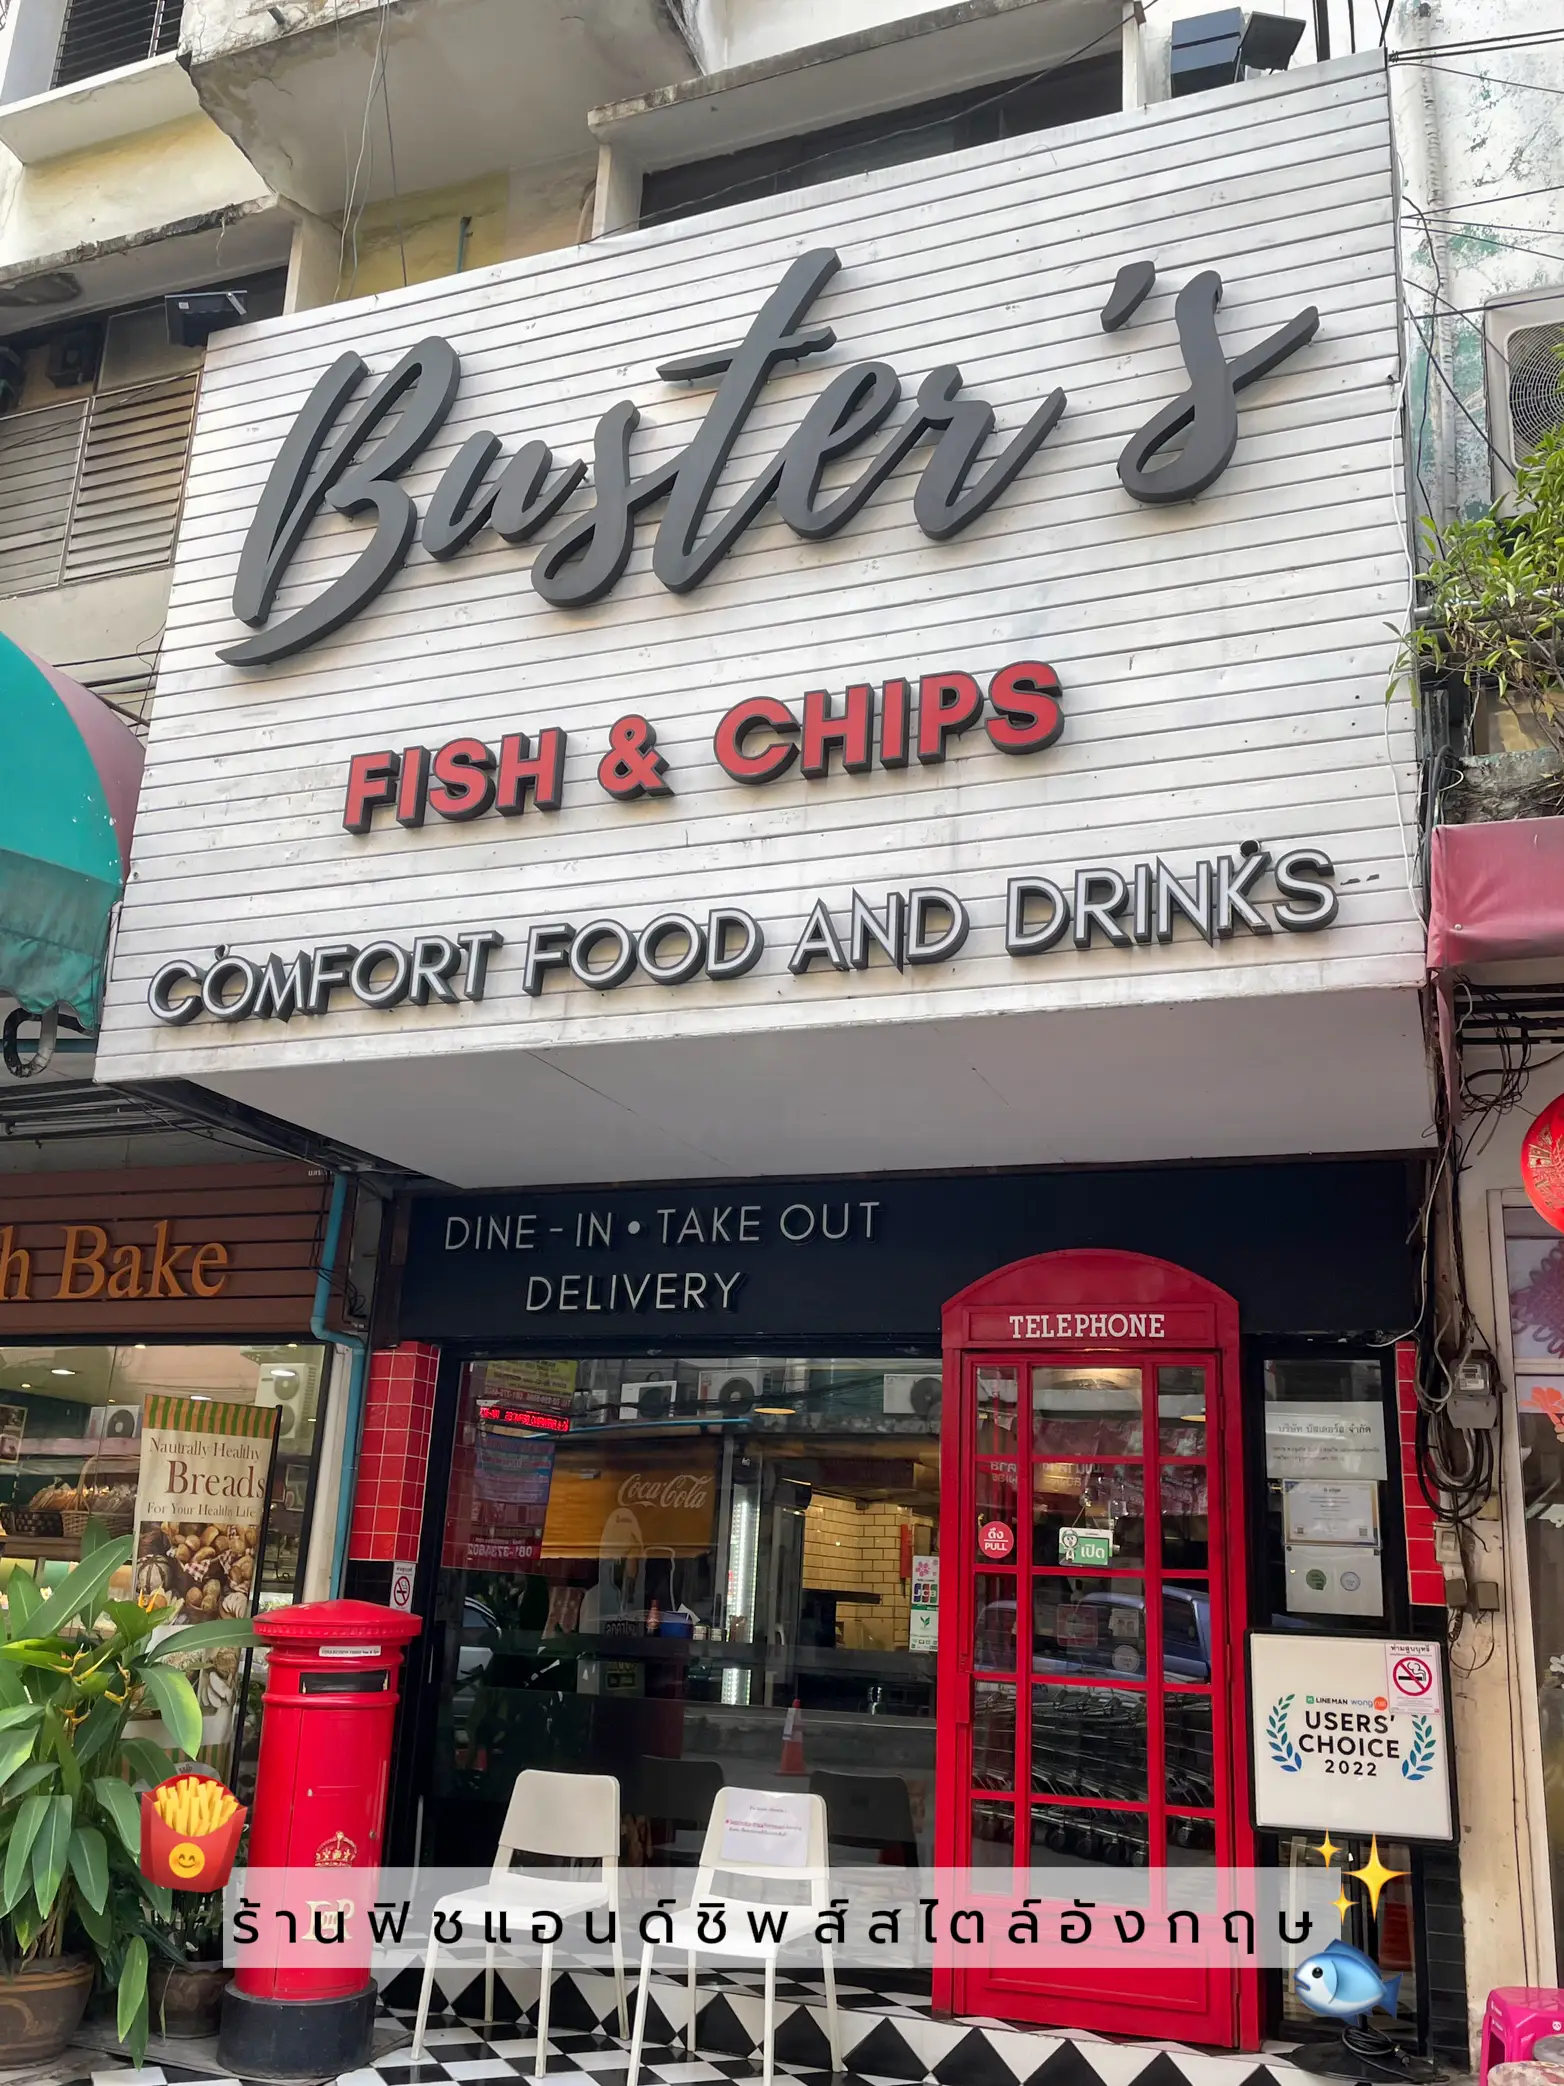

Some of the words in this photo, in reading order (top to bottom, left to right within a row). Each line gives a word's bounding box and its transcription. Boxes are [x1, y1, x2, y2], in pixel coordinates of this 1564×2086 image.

[216, 247, 1321, 668] Buster's
[343, 727, 568, 834] FISH
[598, 714, 674, 801] &
[713, 660, 1065, 787] CHIPS
[147, 930, 503, 1025] COMFORT
[522, 907, 765, 996] FOOD
[788, 887, 969, 974] AND
[1005, 845, 1339, 956] DRINKS
[656, 1206, 761, 1244] TAKE
[779, 1202, 880, 1244] OUT
[51, 1220, 229, 1300] Bake
[526, 1271, 744, 1312] DELIVERY
[1009, 1313, 1165, 1339] TELEPHONE
[213, 1442, 262, 1463] Healthy
[164, 1459, 266, 1499] Breads
[147, 1501, 166, 1514] For
[171, 1502, 196, 1516] Your
[236, 1506, 257, 1518] Life
[987, 1526, 1004, 1540] ดึง
[984, 1542, 1007, 1551] PULL
[1080, 1543, 1105, 1559] เปิด
[1305, 1710, 1395, 1734] USERS'
[1298, 1733, 1400, 1759] CHOICE
[1325, 1759, 1377, 1777] 2022
